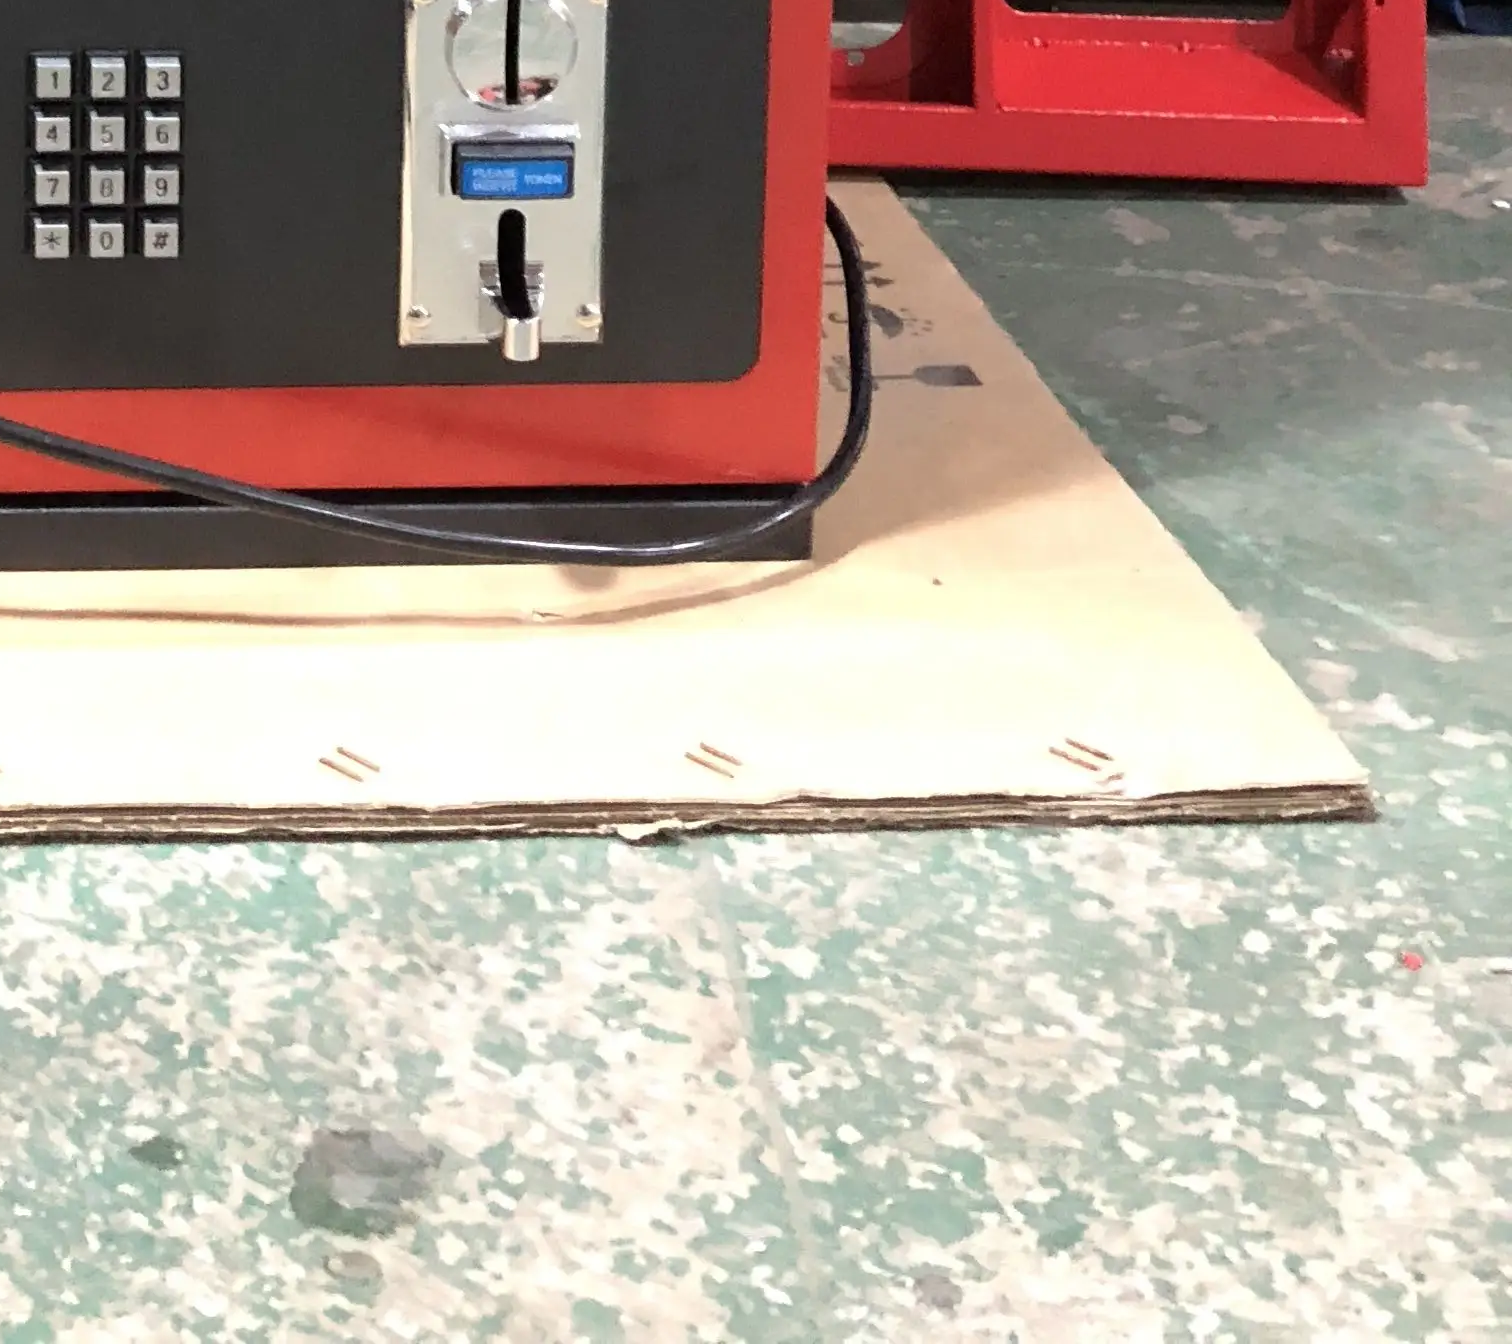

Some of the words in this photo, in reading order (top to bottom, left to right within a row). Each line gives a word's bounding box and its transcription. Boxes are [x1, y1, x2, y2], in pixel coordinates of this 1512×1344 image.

[50, 71, 59, 90] 1
[101, 71, 115, 92] 2
[155, 70, 170, 91] 3
[46, 124, 58, 144] 4
[100, 124, 114, 144] 5
[155, 123, 170, 144] 6
[46, 177, 60, 198] 7
[99, 177, 114, 198] 8
[154, 177, 169, 197] 9
[99, 230, 114, 251] 0
[152, 231, 170, 250] #
